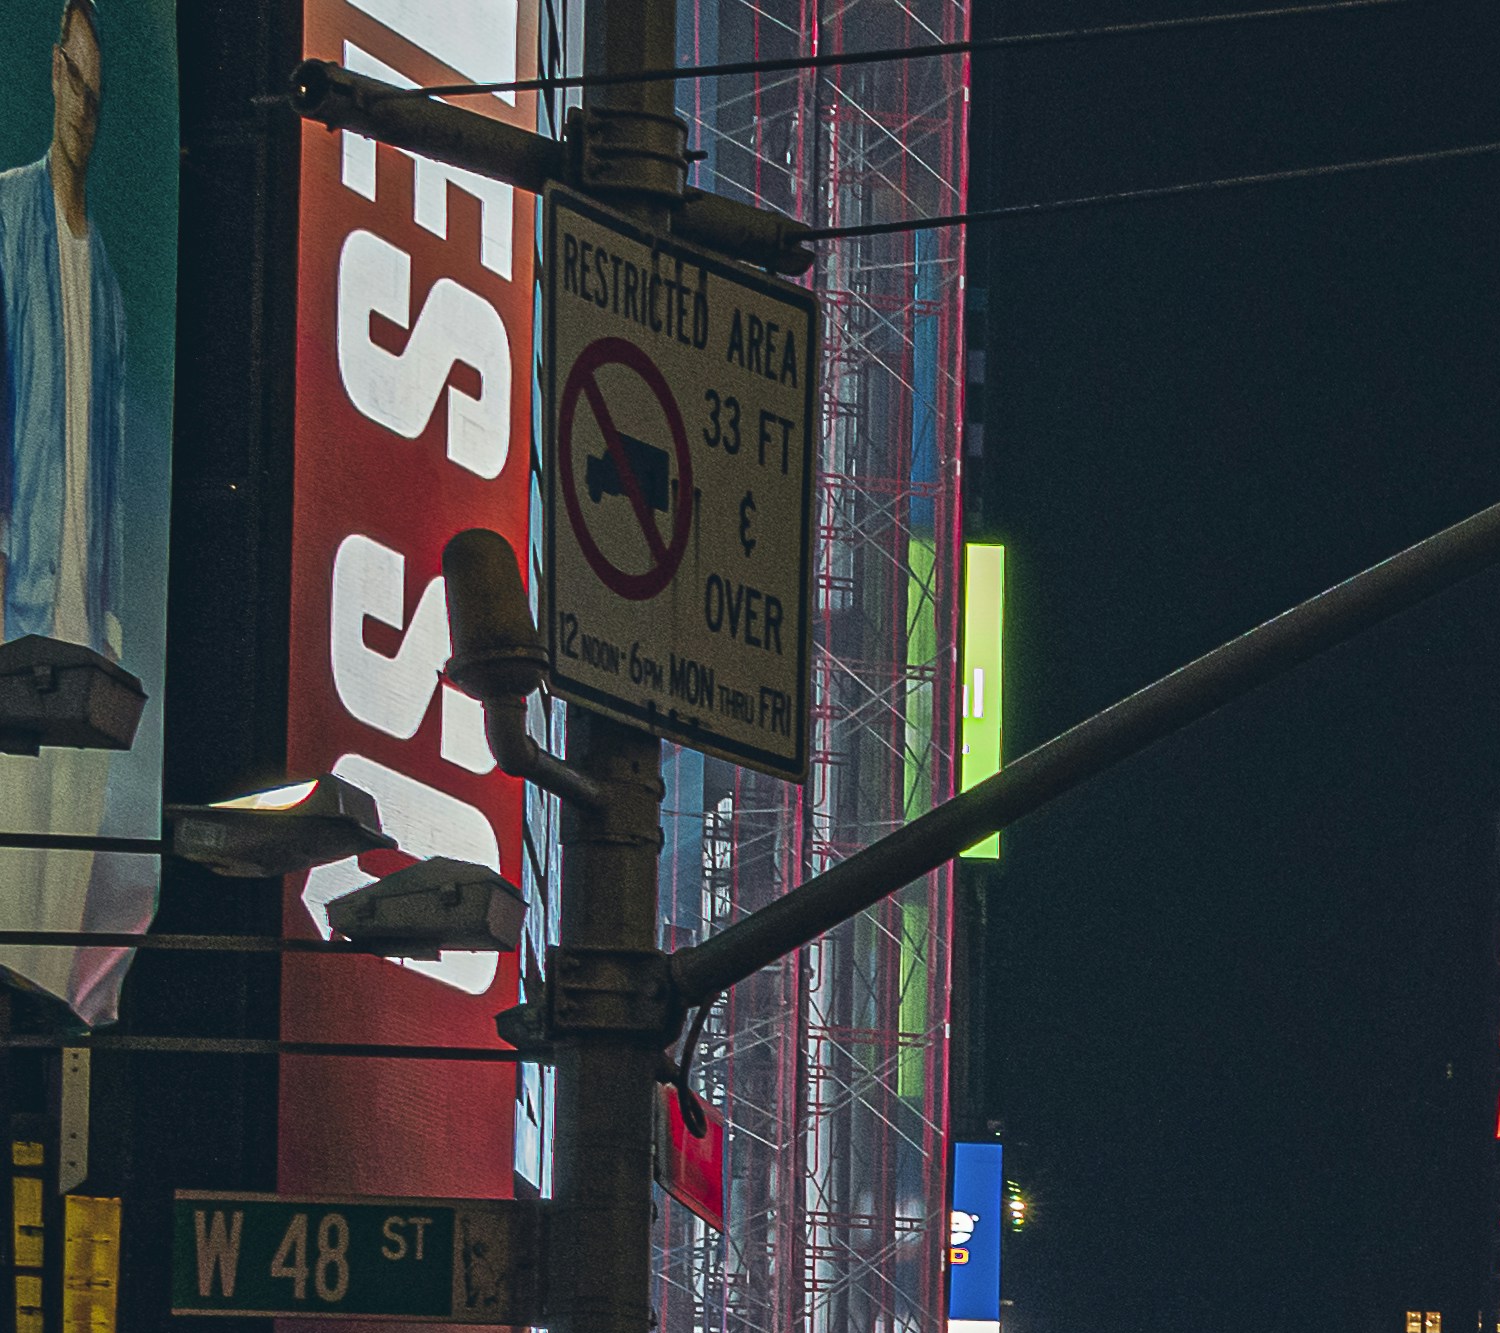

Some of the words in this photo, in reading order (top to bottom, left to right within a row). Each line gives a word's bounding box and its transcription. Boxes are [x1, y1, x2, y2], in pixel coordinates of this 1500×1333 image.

[562, 233, 709, 350] RESTRICTED
[727, 306, 799, 389] AREA
[703, 389, 741, 455] 33
[758, 415, 796, 474] FT
[705, 573, 783, 655] OVER
[669, 654, 715, 709] MON
[759, 684, 792, 738] FRI
[195, 1211, 244, 1298] W
[270, 1214, 350, 1303] 48
[381, 1217, 433, 1259] ST
